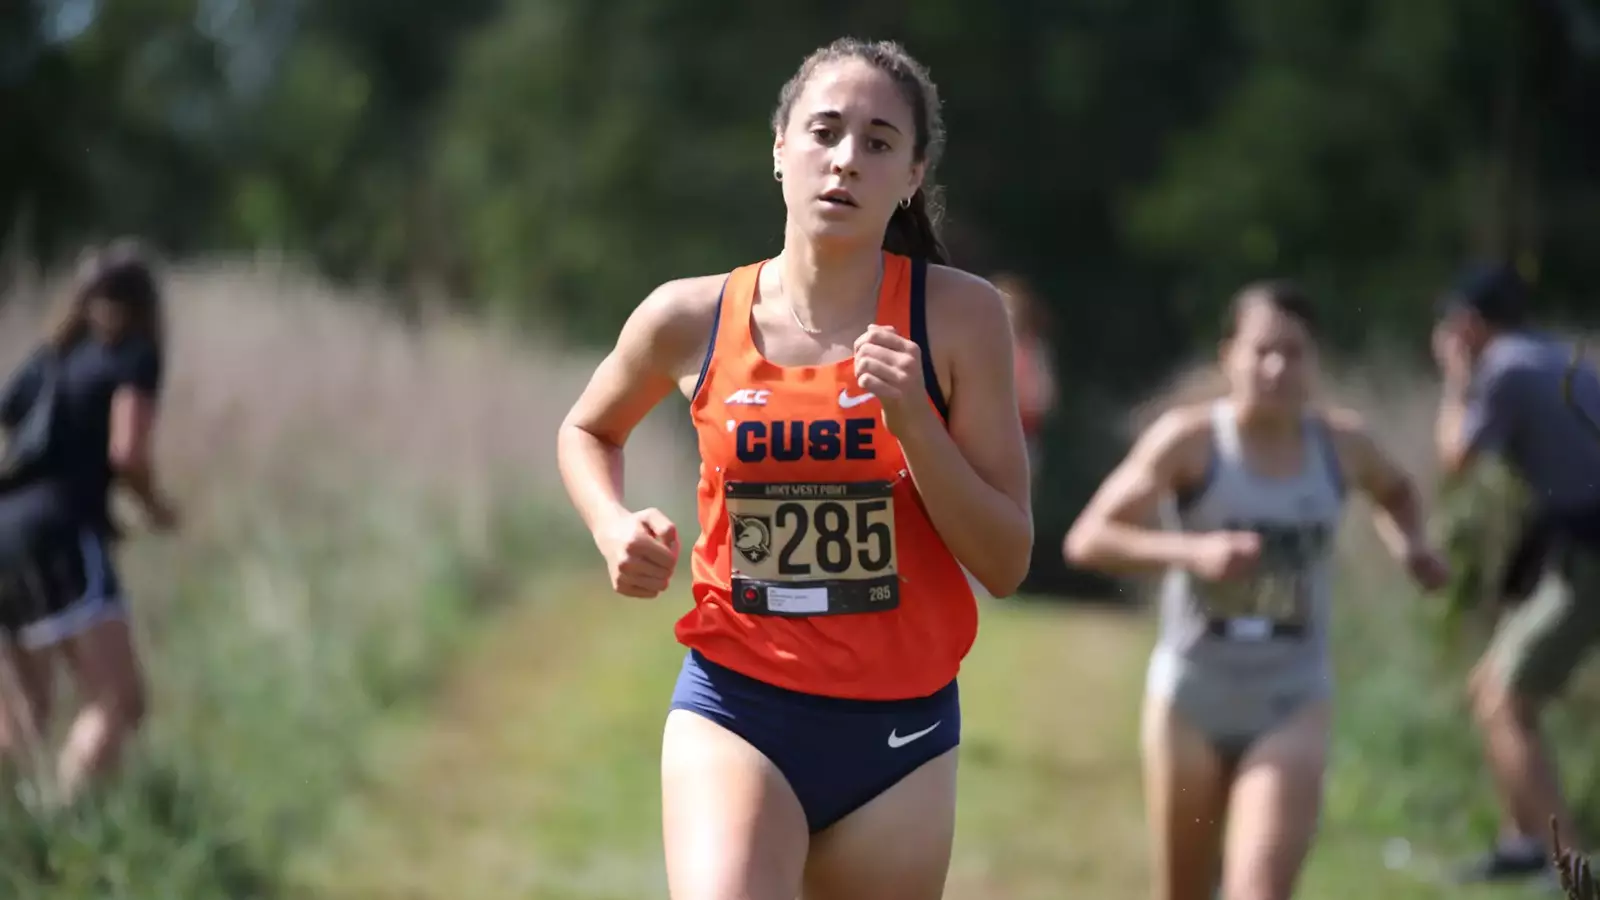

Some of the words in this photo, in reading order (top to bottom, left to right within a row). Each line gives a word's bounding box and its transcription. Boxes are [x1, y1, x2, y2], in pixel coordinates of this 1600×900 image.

[724, 389, 772, 405] ACC
[791, 484, 820, 495] WEST
[822, 484, 847, 495] POINT
[775, 500, 892, 575] 285
[869, 585, 891, 601] 285
